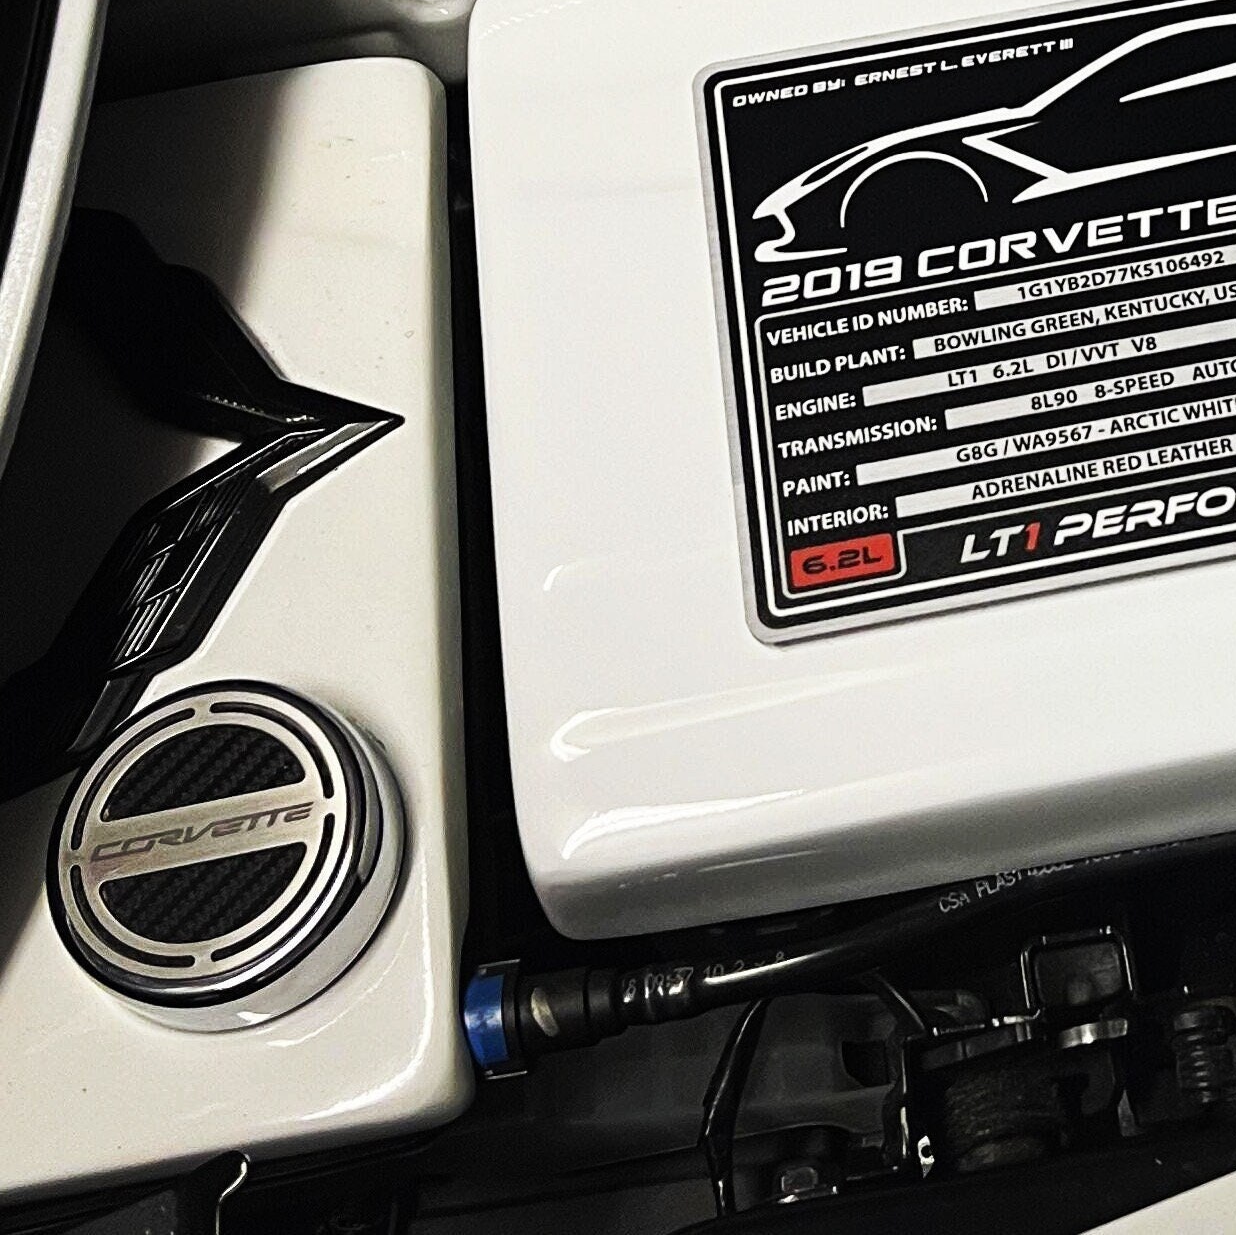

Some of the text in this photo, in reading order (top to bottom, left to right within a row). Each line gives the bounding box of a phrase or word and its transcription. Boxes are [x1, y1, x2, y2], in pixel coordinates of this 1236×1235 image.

[732, 37, 1074, 107] OWNED BY: ERNEST L. EVERETT III
[762, 255, 902, 307] 2019
[766, 250, 1225, 346] VEHICLE ID NUMBER: 1G1YB2D77K5106492
[770, 360, 831, 384] BUILD
[835, 345, 906, 371] PLANT:
[934, 322, 1026, 352] BOWLING
[1031, 310, 1100, 334] GREEN,
[1104, 290, 1210, 321] KENTUCKY,
[775, 392, 856, 421] ENGINE:
[948, 368, 978, 388] LT1
[993, 359, 1034, 379] 6.2L
[1131, 336, 1157, 353] V8
[778, 415, 937, 459] TRANSMISSION:
[1031, 390, 1077, 410] 8L90
[1094, 371, 1174, 399] 8-SPEED
[782, 470, 850, 497] PAINT:
[956, 445, 998, 463] G8G
[1012, 425, 1092, 453] WA9567
[1110, 408, 1180, 435] ARCTIC
[787, 438, 1233, 537] INTERIOR: ADRENALINE RED LEATHER
[802, 546, 882, 575] 6.2L
[960, 521, 1041, 564] LT1
[90, 801, 314, 864] CORVETTE
